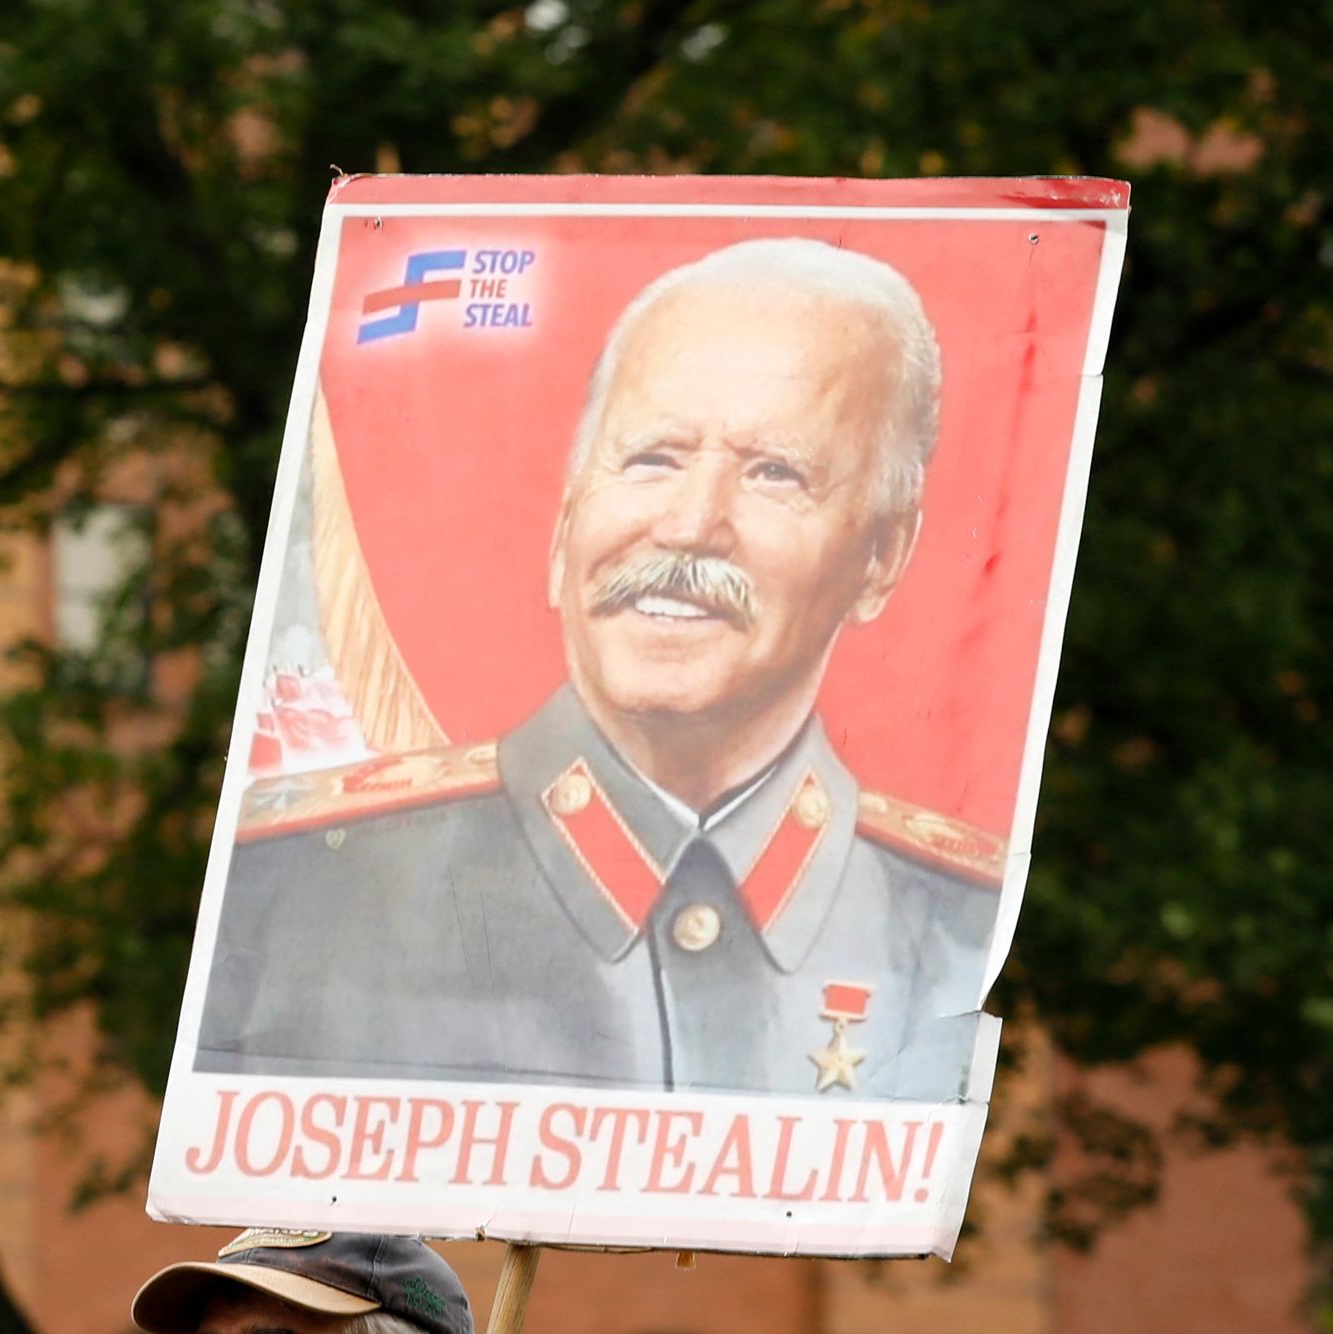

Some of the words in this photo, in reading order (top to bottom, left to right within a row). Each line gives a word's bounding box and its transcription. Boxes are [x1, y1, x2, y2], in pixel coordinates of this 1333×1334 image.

[472, 250, 536, 275] STOP
[470, 278, 508, 299] THE
[463, 303, 533, 328] STEAL
[184, 1090, 519, 1186] JOSEPH
[528, 1102, 945, 1204] STEALIN!
